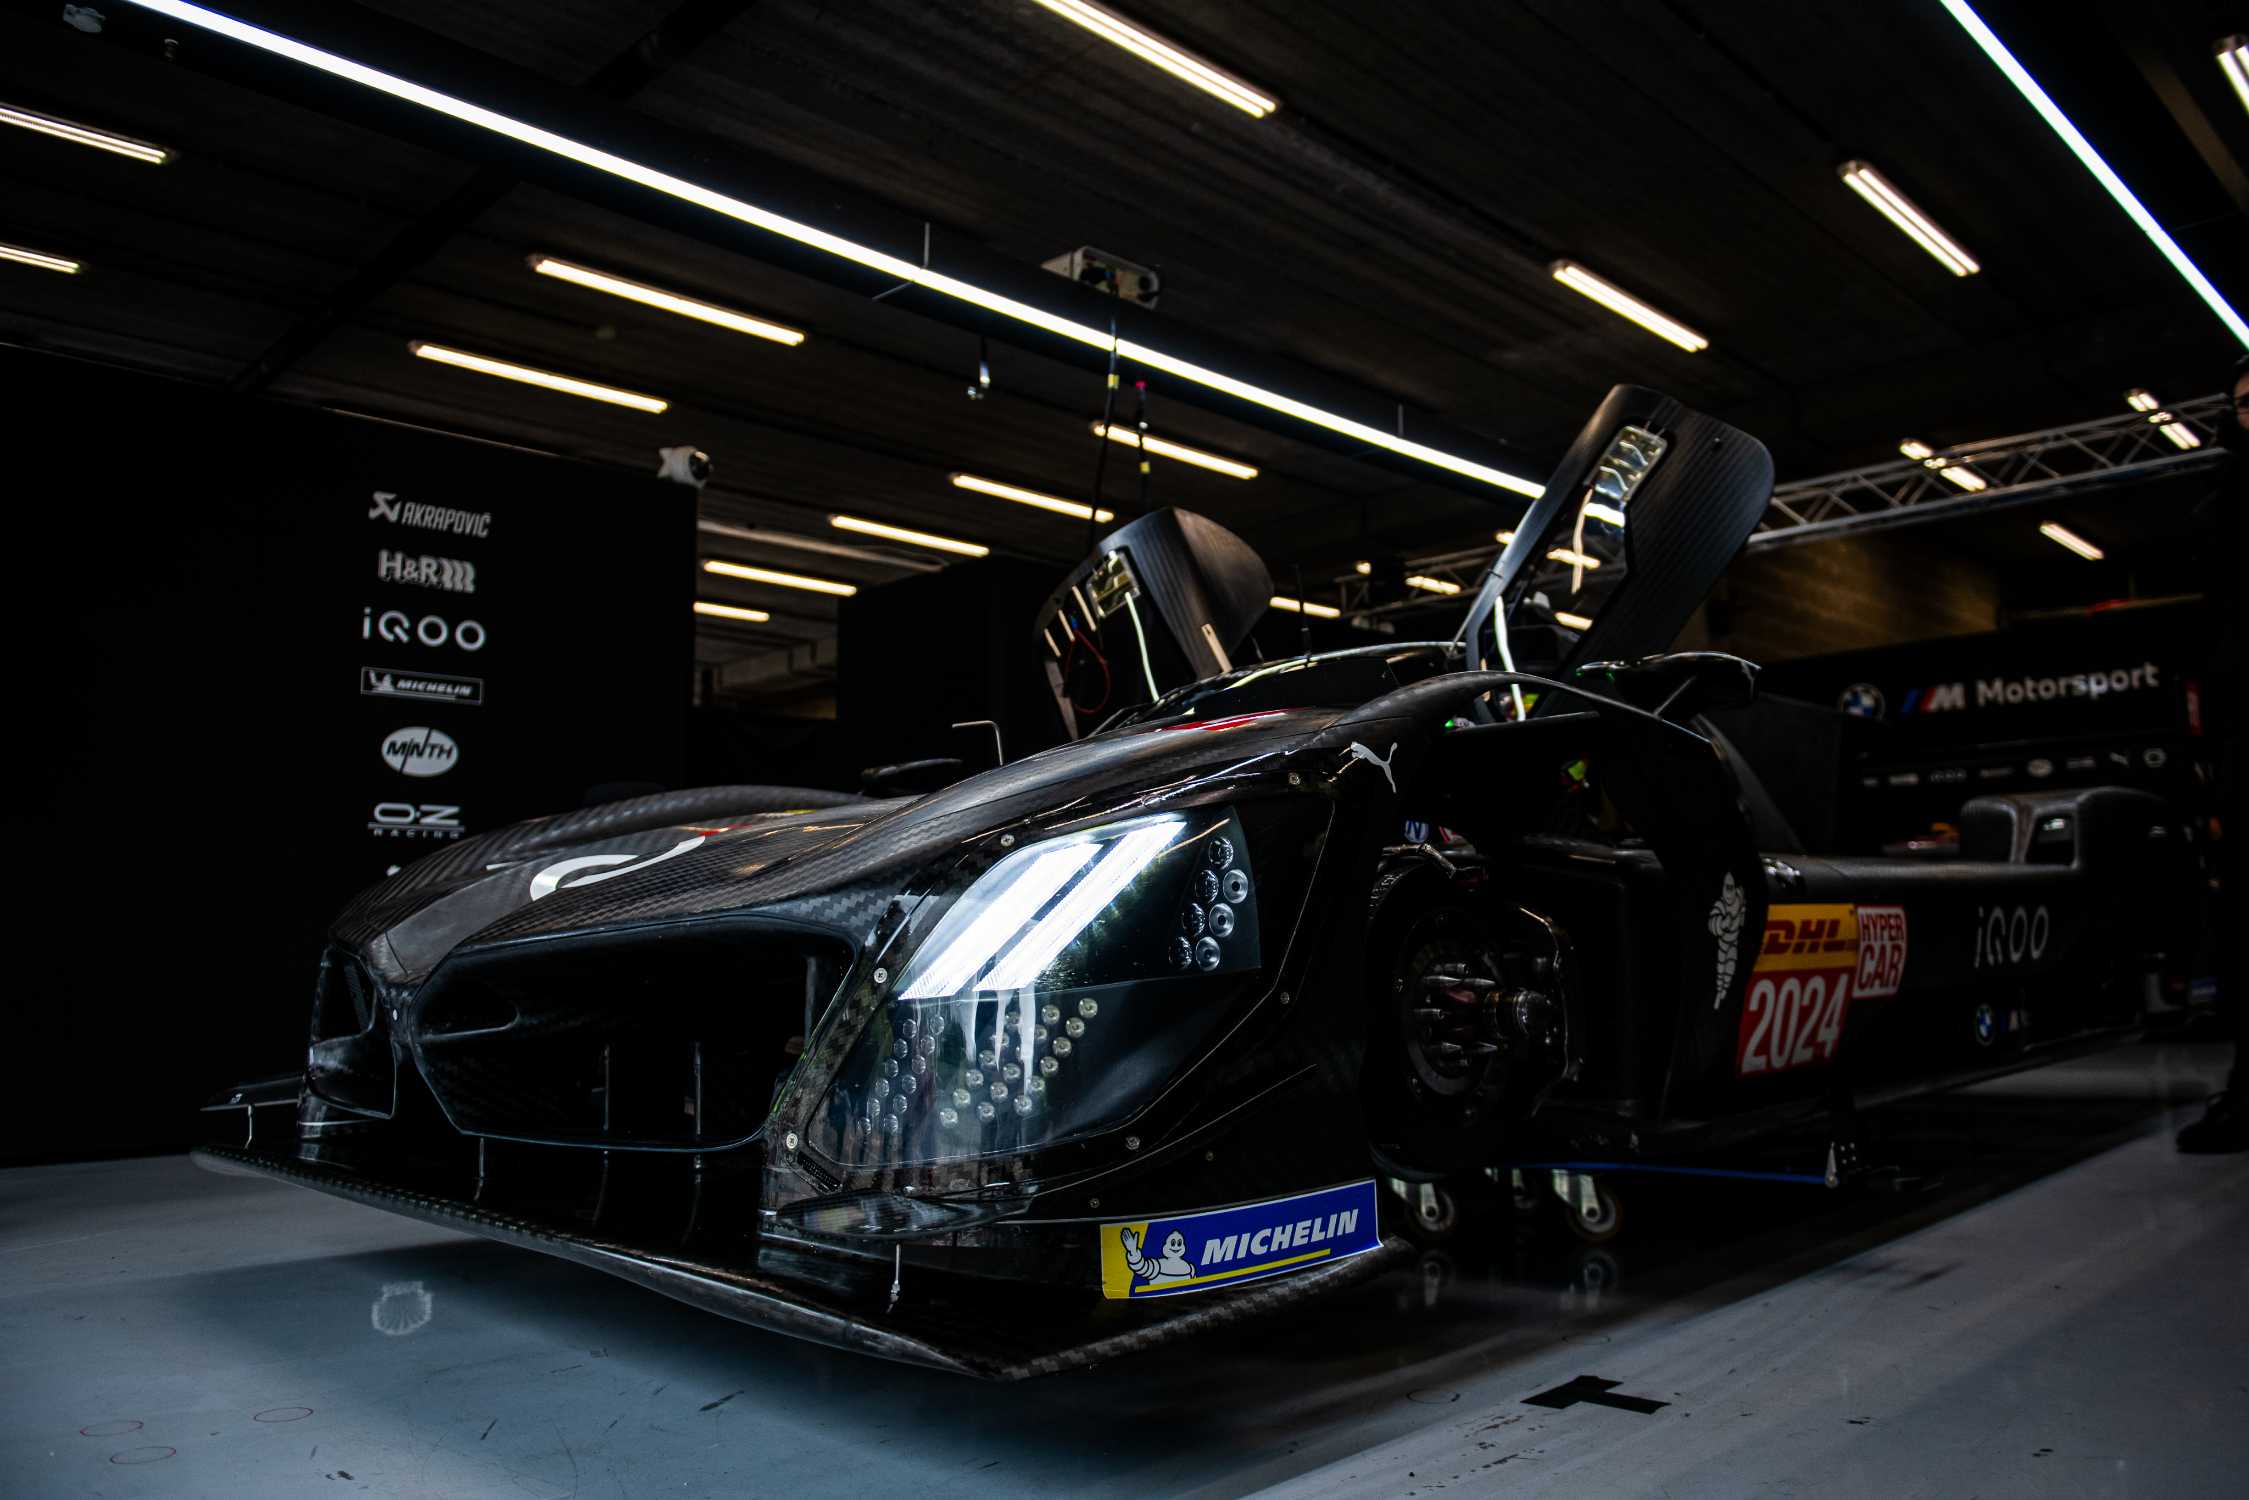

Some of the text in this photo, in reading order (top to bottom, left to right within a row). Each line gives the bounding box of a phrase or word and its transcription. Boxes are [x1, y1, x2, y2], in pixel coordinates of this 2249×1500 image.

[362, 606, 487, 652] iQOO
[397, 678, 474, 697] MICHELIN
[1975, 662, 2159, 707] Motorsport
[1763, 919, 1847, 955] DHL
[1860, 913, 1904, 943] HYPER
[1974, 905, 2050, 968] iQOO
[1857, 942, 1904, 991] CAR
[1741, 973, 1849, 1073] 2024
[1200, 1208, 1359, 1266] MICHELIN
